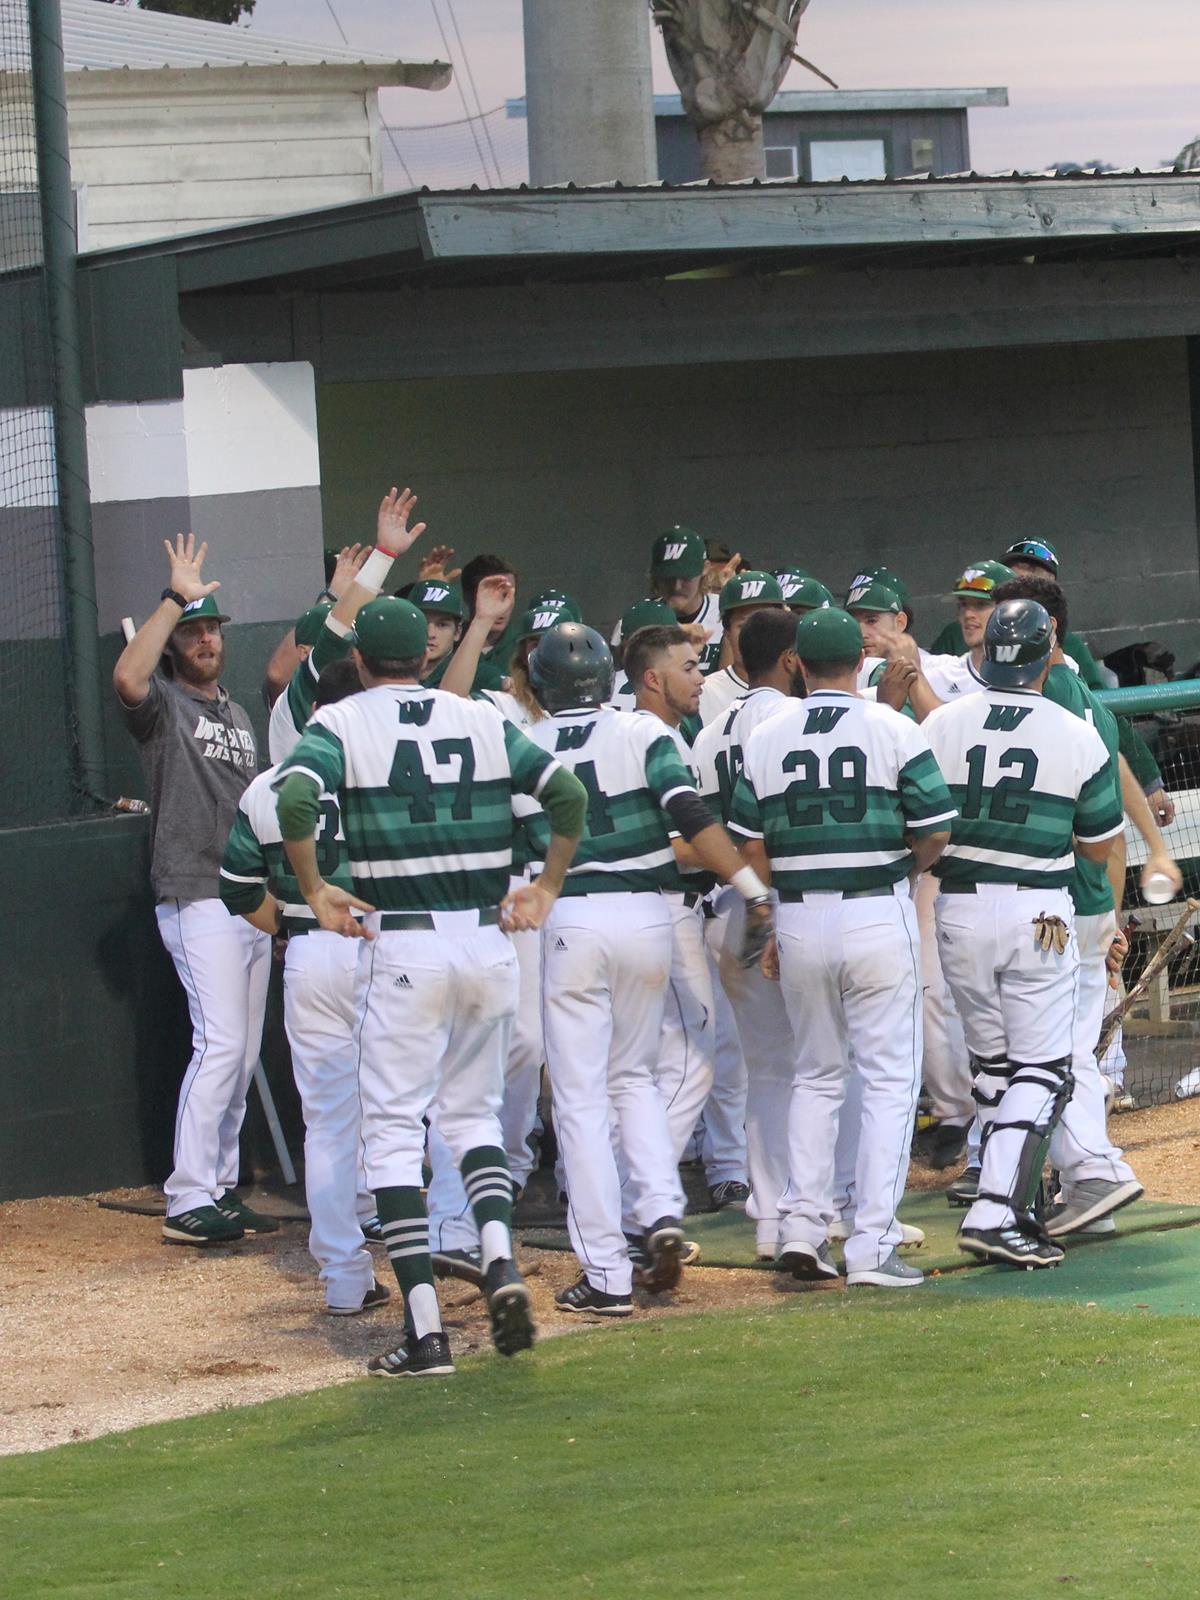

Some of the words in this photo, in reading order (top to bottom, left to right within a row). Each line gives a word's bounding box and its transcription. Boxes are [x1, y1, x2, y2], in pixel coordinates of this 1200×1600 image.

[663, 543, 687, 560] W
[423, 586, 450, 602] W
[740, 580, 766, 599] W
[532, 611, 560, 629] W
[995, 644, 1021, 662] W
[396, 698, 435, 727] W
[803, 706, 850, 735] W
[983, 704, 1033, 731] W
[555, 721, 597, 751] W
[388, 737, 475, 824] 47
[782, 746, 867, 827] 29
[961, 745, 1039, 824] 12
